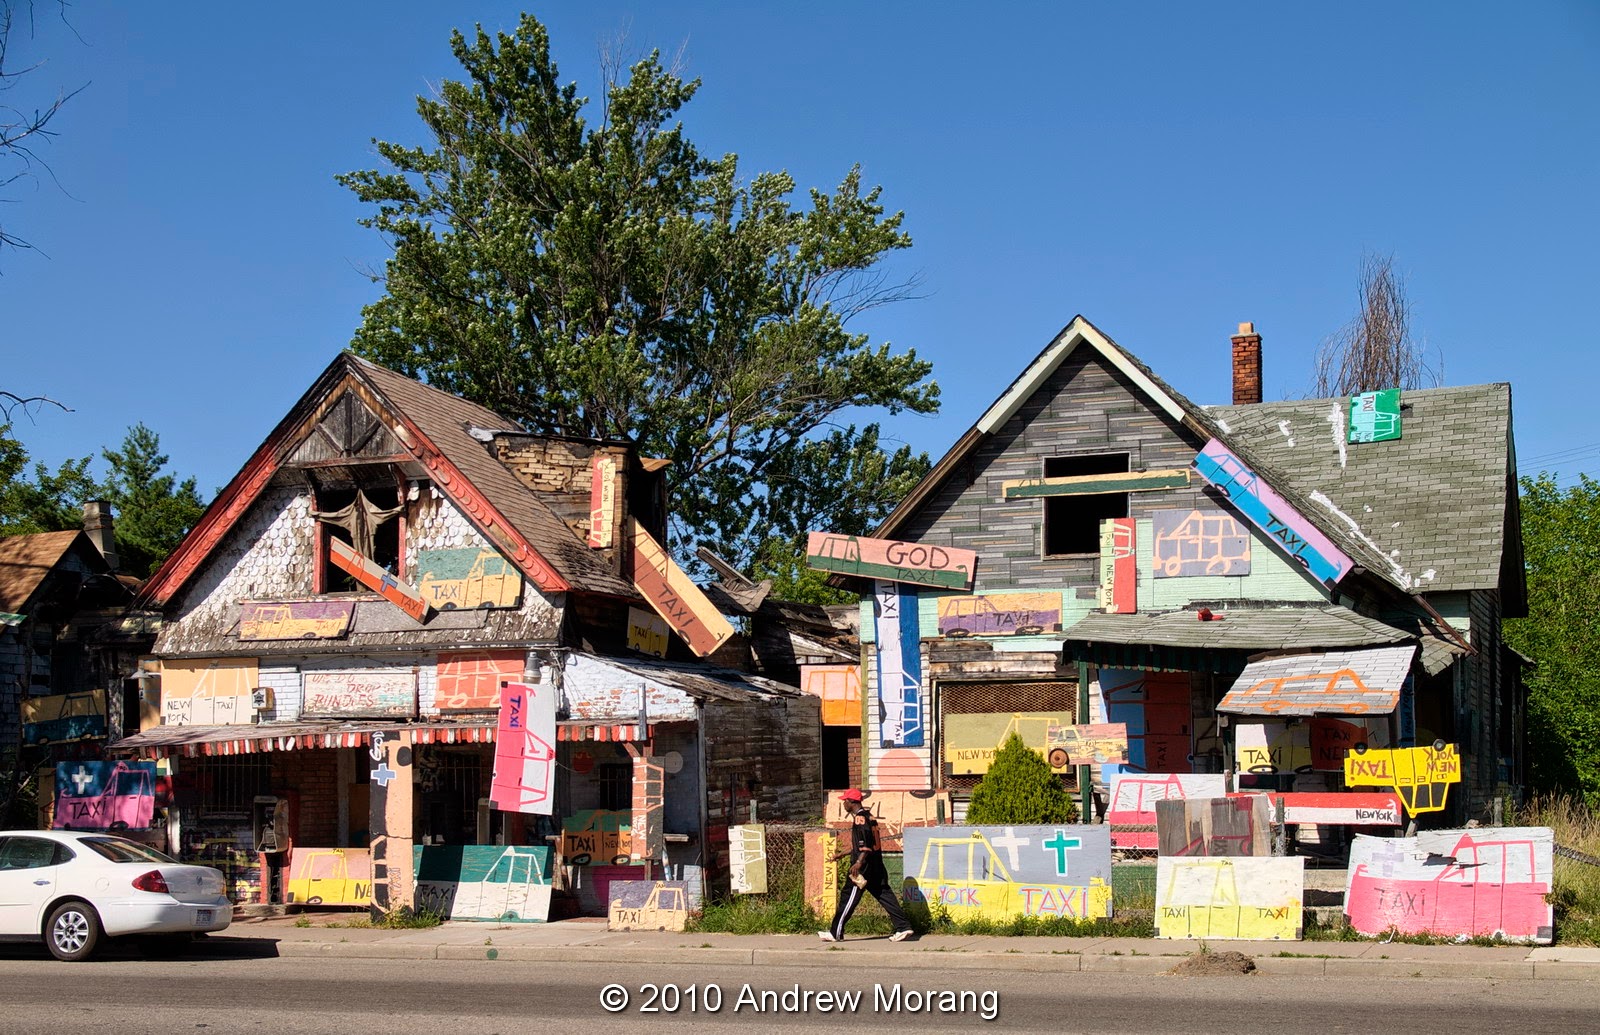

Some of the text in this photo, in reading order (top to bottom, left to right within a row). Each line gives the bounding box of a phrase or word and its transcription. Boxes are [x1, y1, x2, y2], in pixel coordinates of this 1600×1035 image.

[886, 541, 950, 570] GOD
[167, 701, 191, 711] NEW
[957, 749, 980, 761] NEW
[825, 866, 834, 890] NEW
